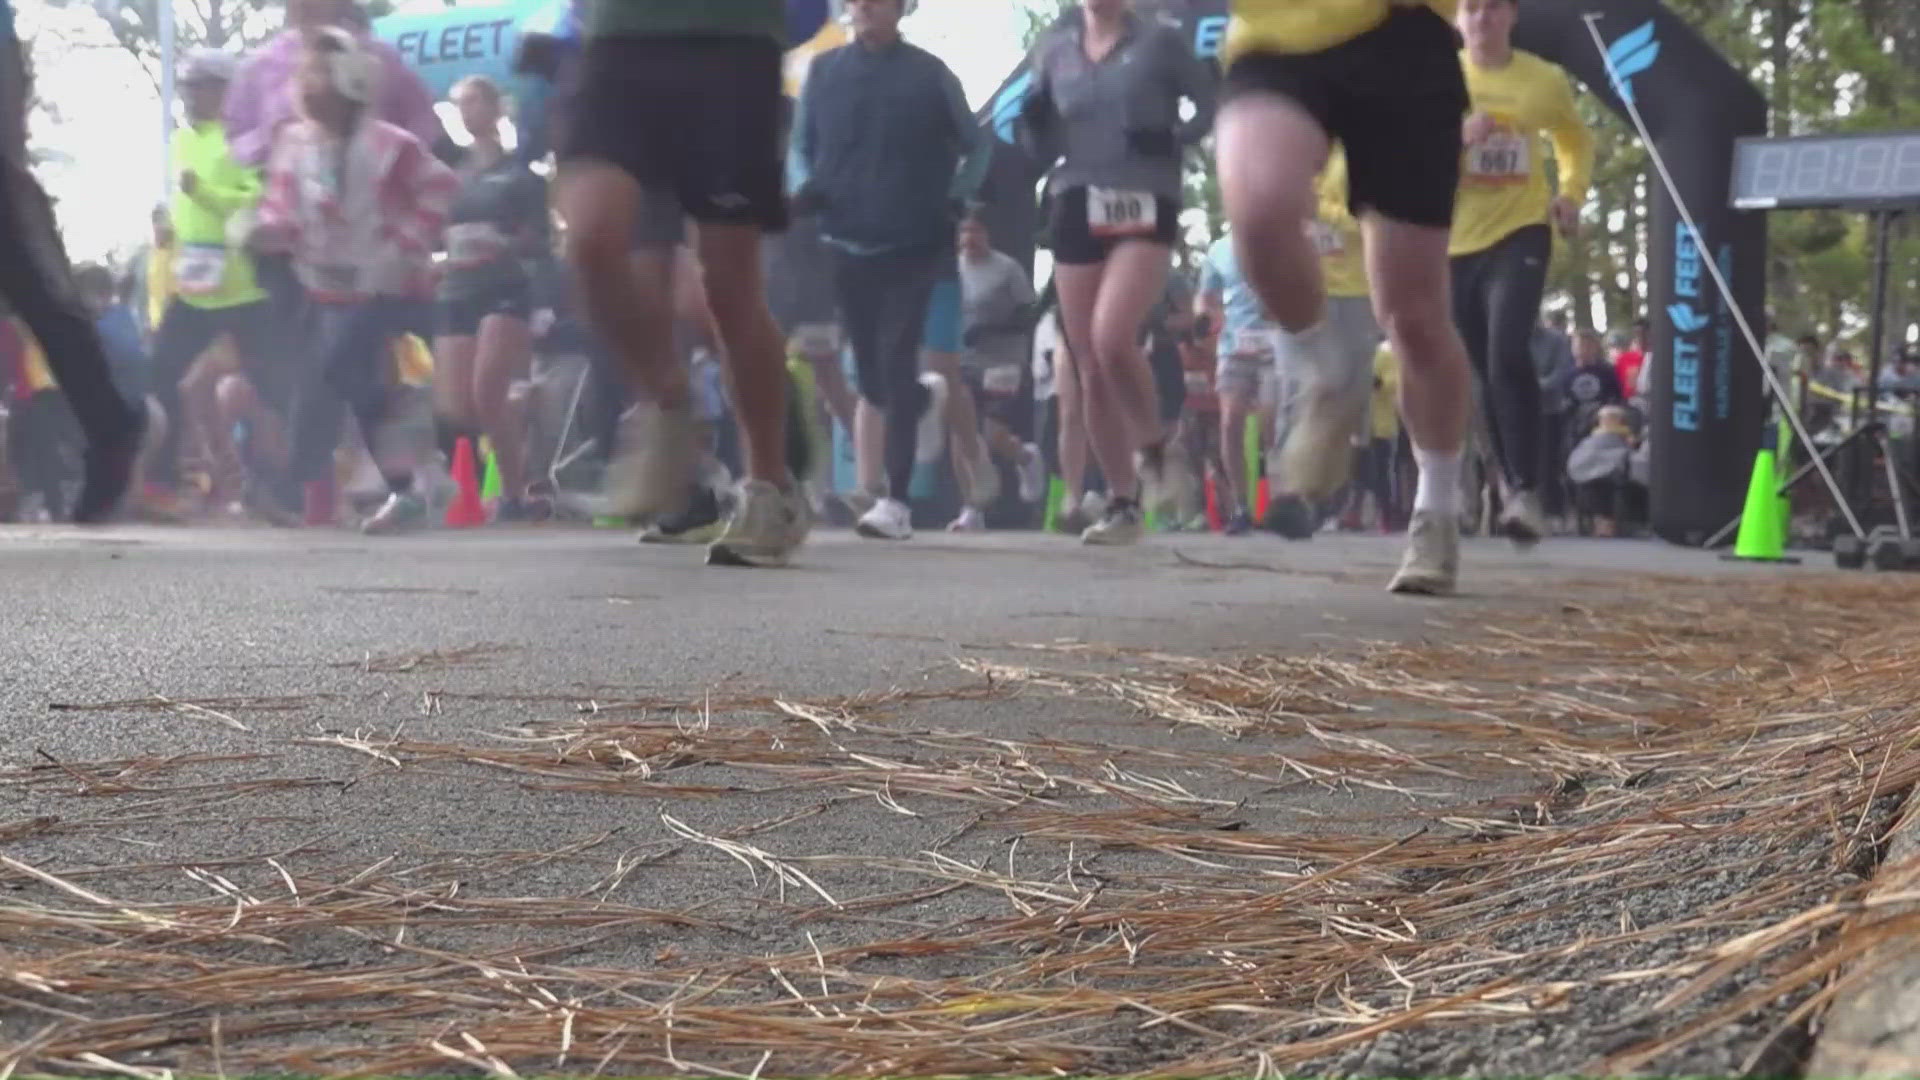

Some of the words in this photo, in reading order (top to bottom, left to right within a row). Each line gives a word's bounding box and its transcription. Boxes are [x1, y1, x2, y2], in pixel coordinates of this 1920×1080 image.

[398, 18, 514, 65] FLEET
[1675, 221, 1701, 297] FEET
[1673, 335, 1700, 431] FLEET
